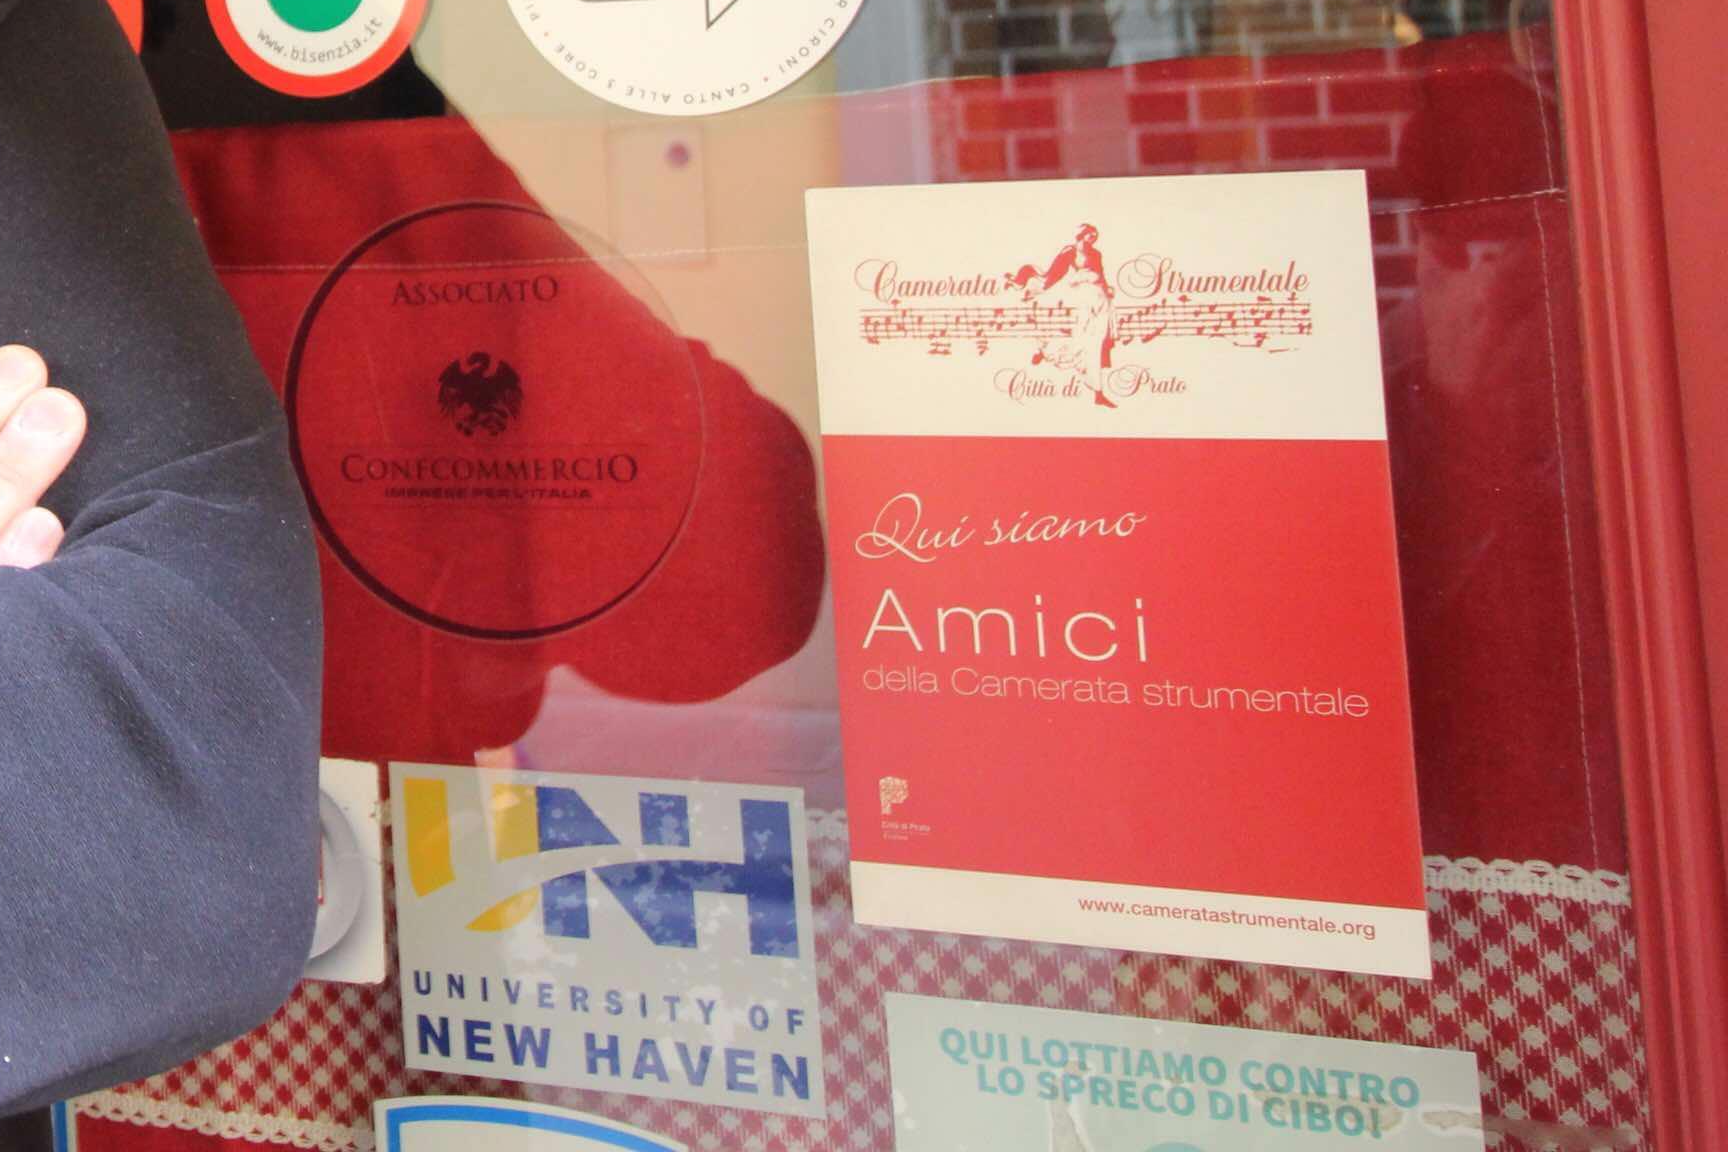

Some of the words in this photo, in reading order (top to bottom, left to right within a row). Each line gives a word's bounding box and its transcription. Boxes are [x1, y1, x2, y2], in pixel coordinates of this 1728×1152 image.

[257, 17, 382, 63] www.bisenzia.it
[779, 16, 836, 75] CIRONI
[625, 84, 672, 104] ALLE
[683, 81, 751, 105] CANTO
[392, 275, 558, 305] ASSOCIATO
[854, 258, 1000, 302] Camerata
[1116, 253, 1311, 297] Strumentale
[993, 367, 1058, 402] Città
[1062, 375, 1082, 398] di
[1107, 364, 1187, 397] Prato
[340, 453, 637, 483] CONFCOMMERCIO
[854, 492, 976, 563] Qui
[983, 510, 1148, 546] siamo
[862, 588, 1148, 662] Amici
[862, 664, 939, 694] della
[951, 667, 1130, 705] Camerata
[1142, 679, 1369, 718] strumentale
[1078, 898, 1376, 941] www.cameratastrumentale.org
[414, 969, 717, 1027] UNIVERSITY
[748, 1003, 805, 1036] OF
[417, 1013, 551, 1069] NEW
[586, 1031, 811, 1100] HAVEN
[938, 1026, 1008, 1064] QUI
[1021, 1037, 1228, 1085] LOTTIAMO
[1240, 1059, 1420, 1109] CONTRO
[975, 1065, 1026, 1097] LO
[1038, 1070, 1196, 1117] SPRECO
[1209, 1090, 1249, 1124] DI
[1263, 1094, 1384, 1139] CIBO!
